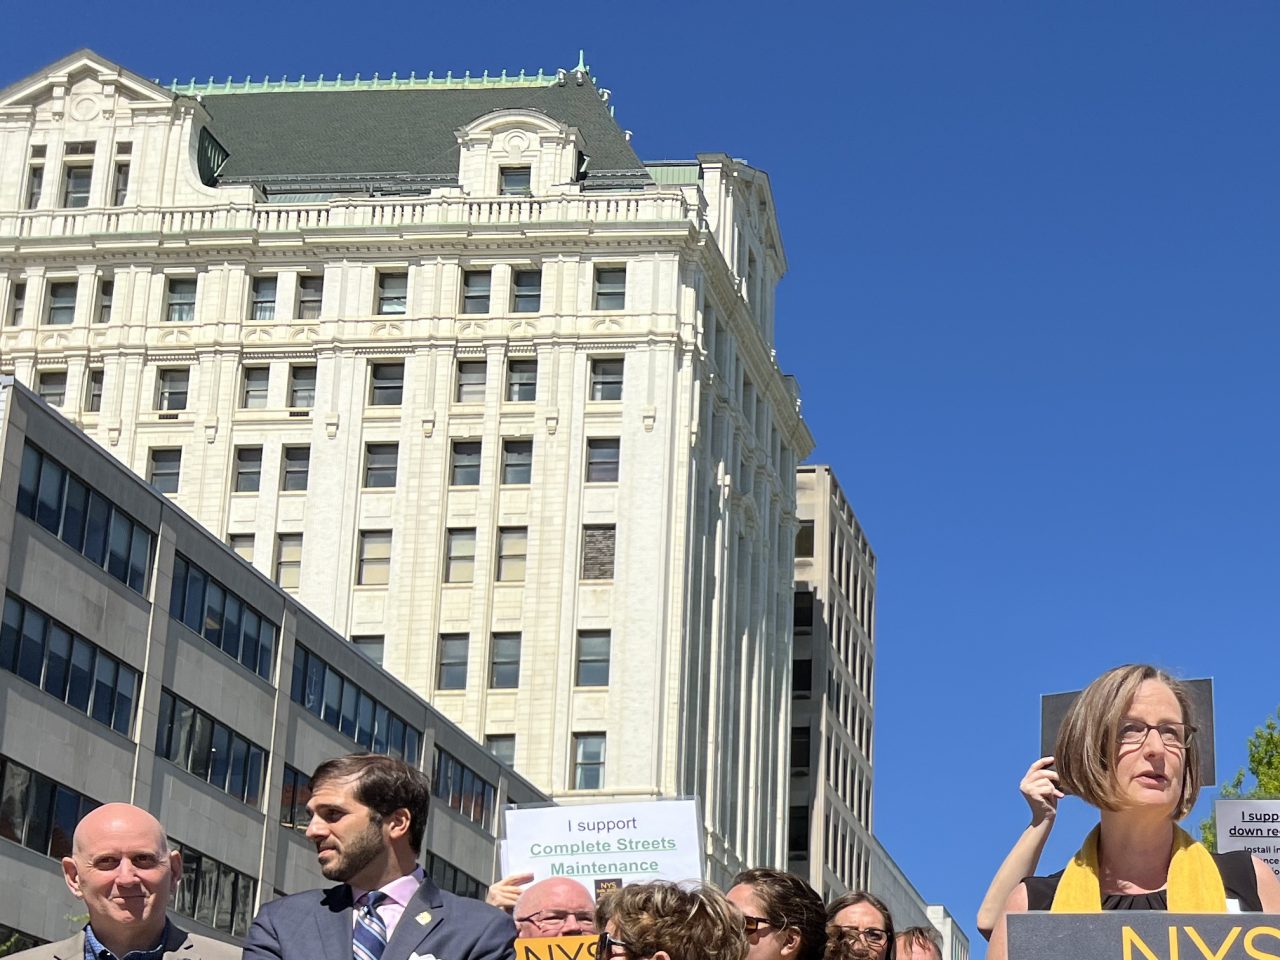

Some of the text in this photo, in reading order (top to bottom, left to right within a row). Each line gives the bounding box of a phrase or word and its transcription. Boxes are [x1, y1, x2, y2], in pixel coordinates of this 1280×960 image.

[568, 817, 637, 833] I support
[1229, 826, 1263, 836] down
[530, 837, 676, 857] Complete Streets
[551, 861, 659, 876] Maintenance
